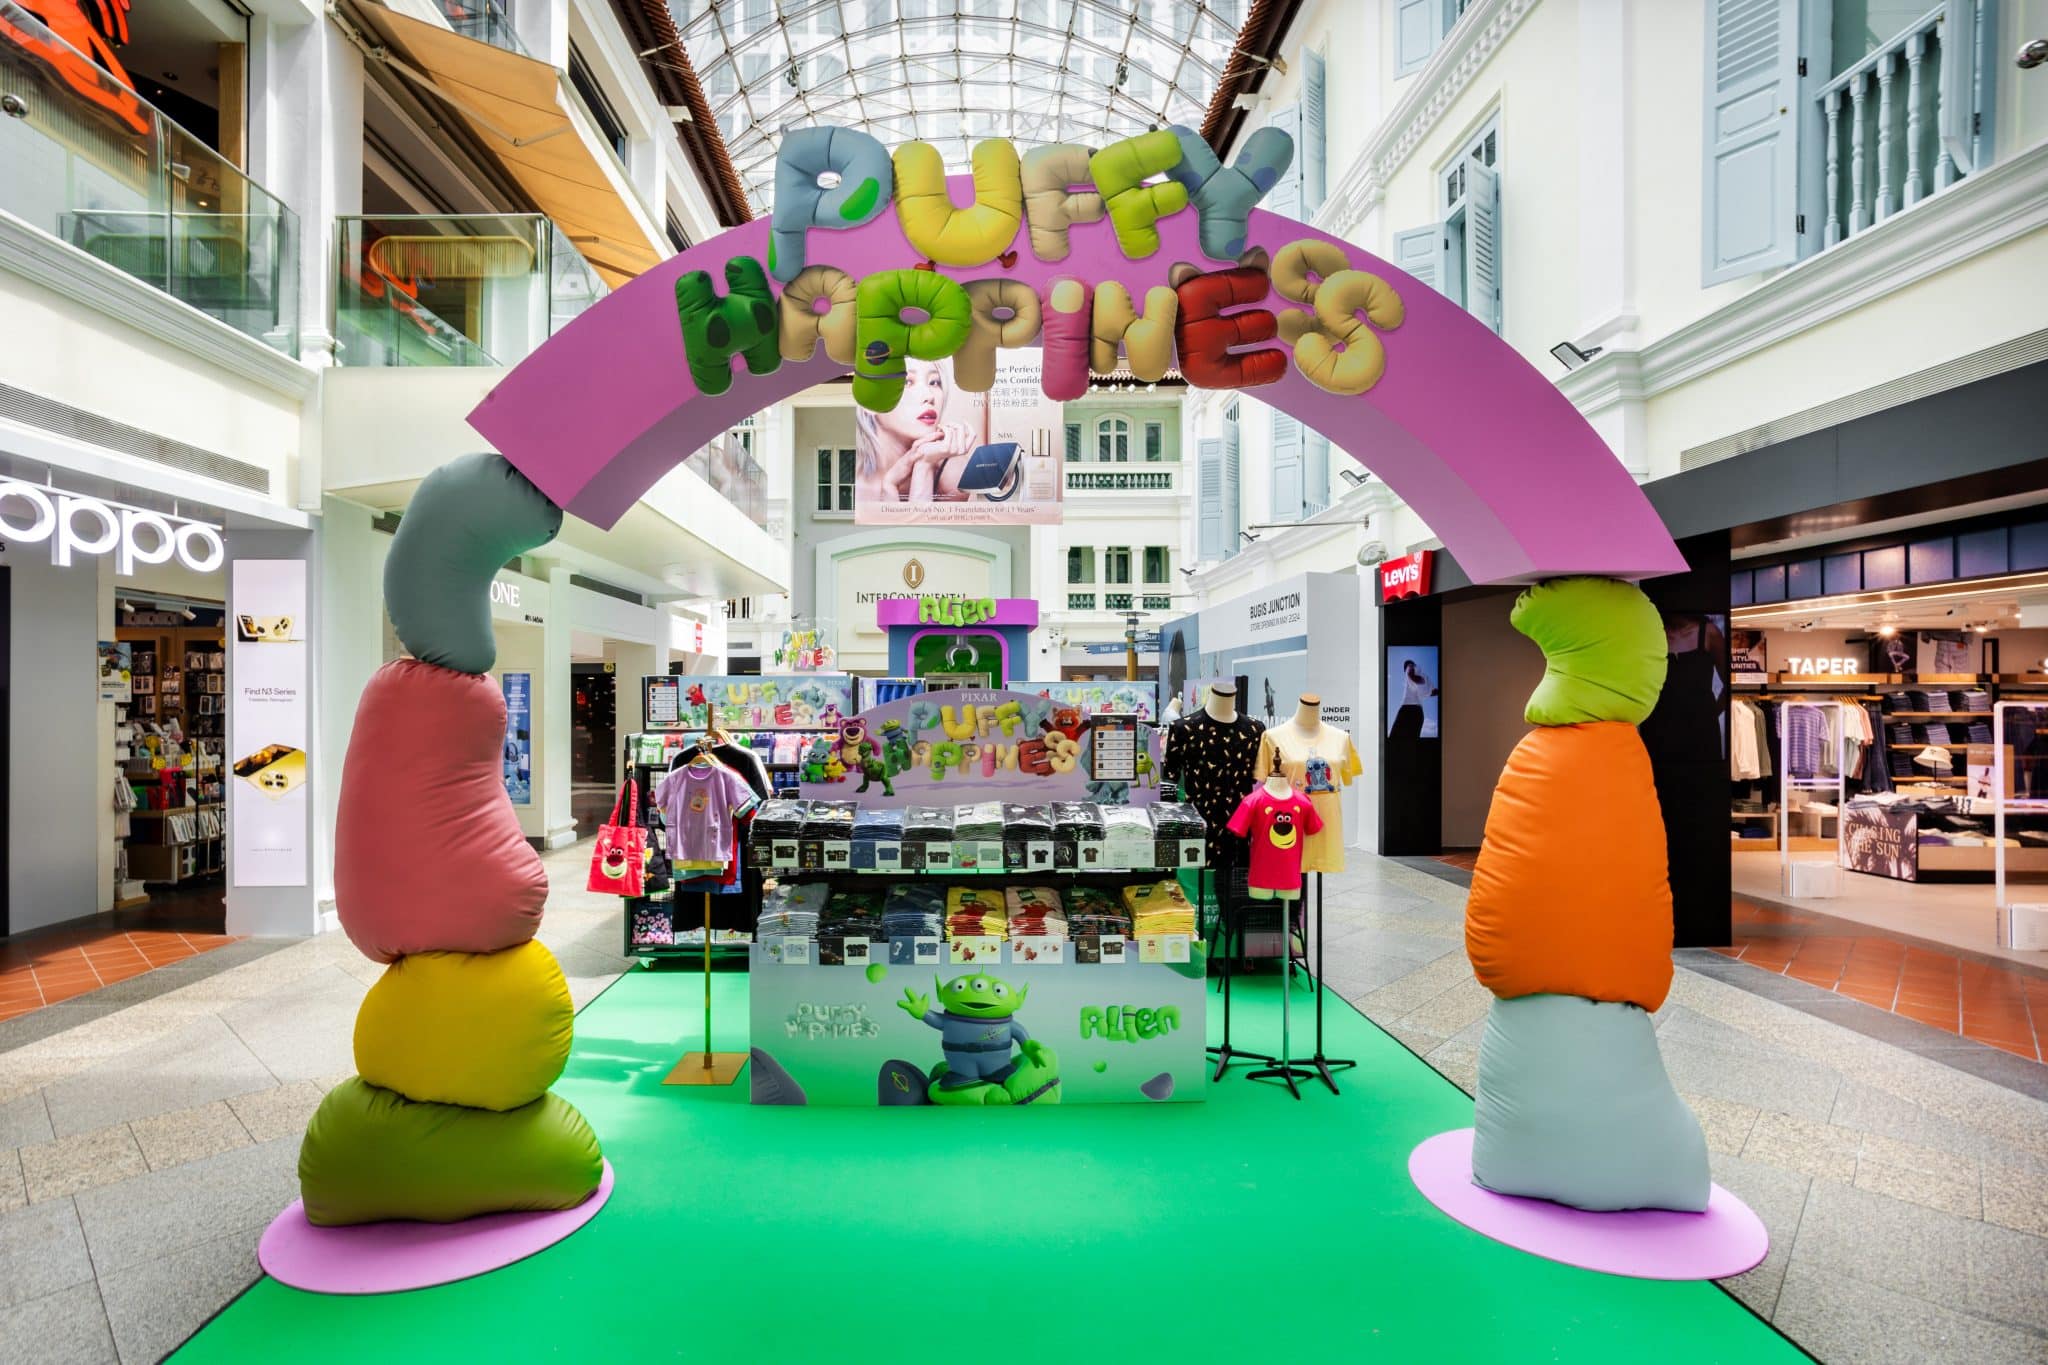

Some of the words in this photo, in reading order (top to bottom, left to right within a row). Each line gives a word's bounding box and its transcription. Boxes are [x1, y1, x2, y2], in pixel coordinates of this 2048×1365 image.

[767, 124, 1294, 283] PUFFY
[675, 239, 1404, 412] HAPPINESS
[490, 580, 520, 607] ONE
[1250, 602, 1267, 619] BUGIS
[1268, 592, 1301, 614] JUNCTION
[1788, 656, 1858, 676] TAPER
[244, 687, 261, 696] Find
[273, 687, 297, 696] Series
[960, 693, 999, 703] PIXAR
[908, 699, 1050, 745] PUFFY
[1321, 715, 1350, 723] RMOUR
[1848, 822, 1901, 843] CHASING
[1876, 841, 1900, 858] SUN
[797, 1000, 867, 1021] PUFFY
